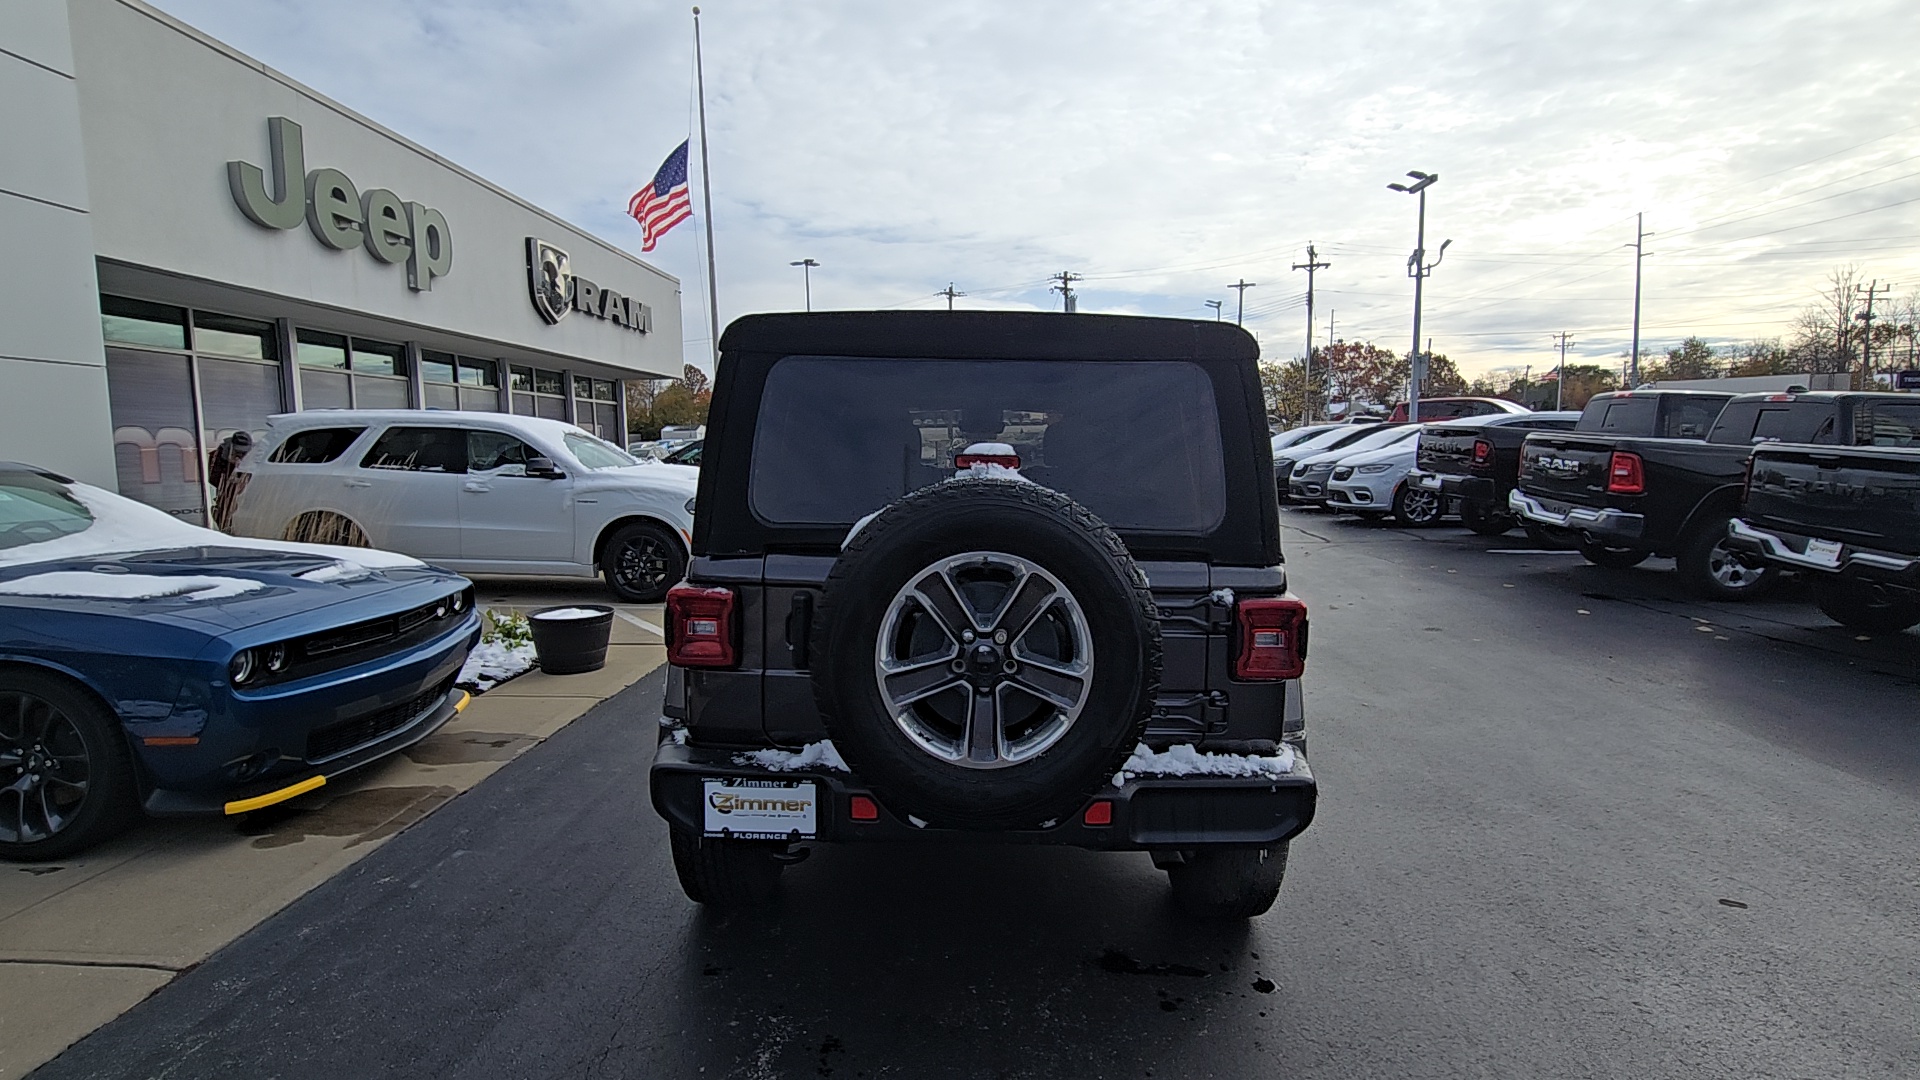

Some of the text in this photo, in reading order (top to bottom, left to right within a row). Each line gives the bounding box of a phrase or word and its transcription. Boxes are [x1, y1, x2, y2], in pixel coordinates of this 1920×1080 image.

[227, 117, 453, 292] Jeep
[571, 275, 653, 335] RAM
[1539, 456, 1579, 472] RAM
[1785, 477, 1866, 500] RAM
[732, 777, 787, 788] Zimmer
[715, 793, 812, 812] Zimmer
[733, 832, 788, 840] FLORENCE
